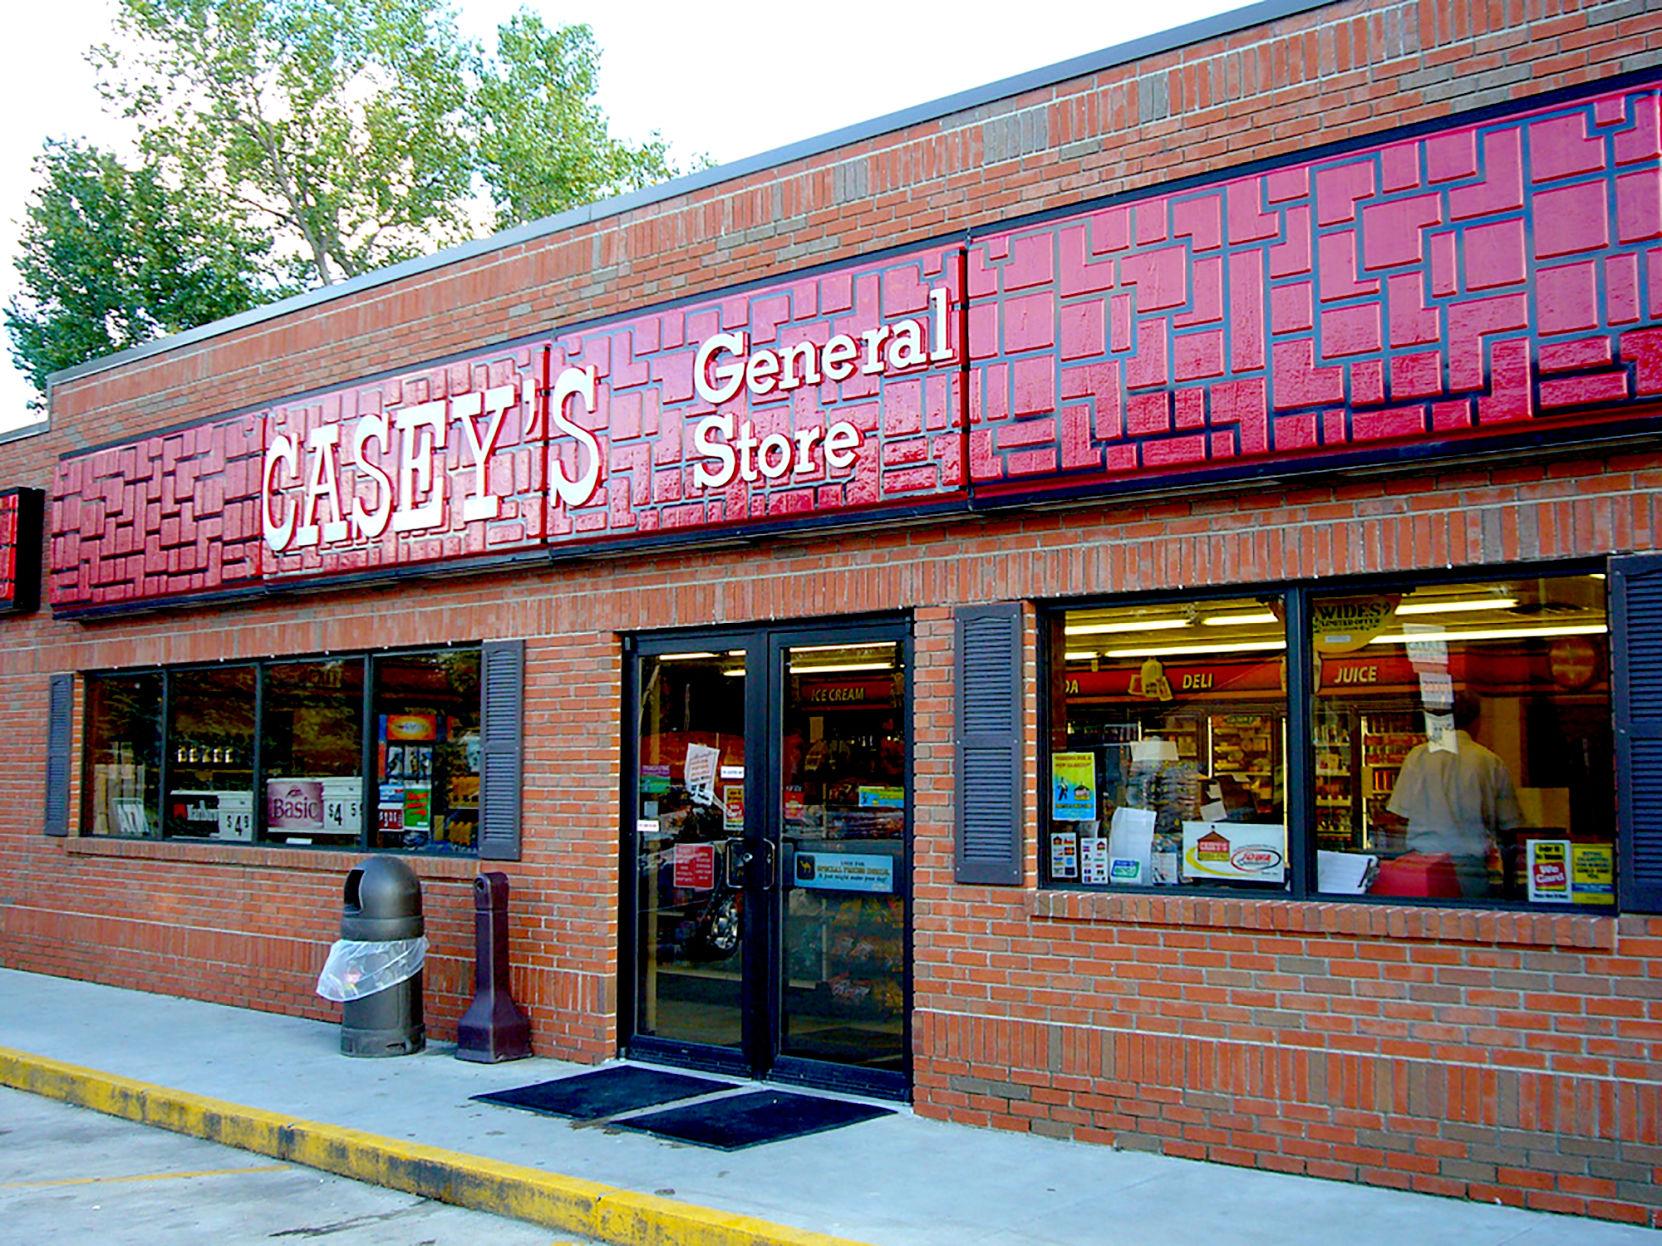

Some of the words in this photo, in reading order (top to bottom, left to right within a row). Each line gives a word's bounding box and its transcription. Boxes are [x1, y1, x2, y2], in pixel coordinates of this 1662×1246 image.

[694, 287, 954, 404] General
[262, 364, 600, 552] CASEY'S
[694, 412, 862, 489] Store
[1182, 672, 1213, 689] DELI
[1333, 665, 1377, 684] JUICE
[811, 689, 827, 702] ICE
[828, 687, 864, 701] CREAM
[272, 796, 319, 819] Basic
[1535, 872, 1565, 883] Card
